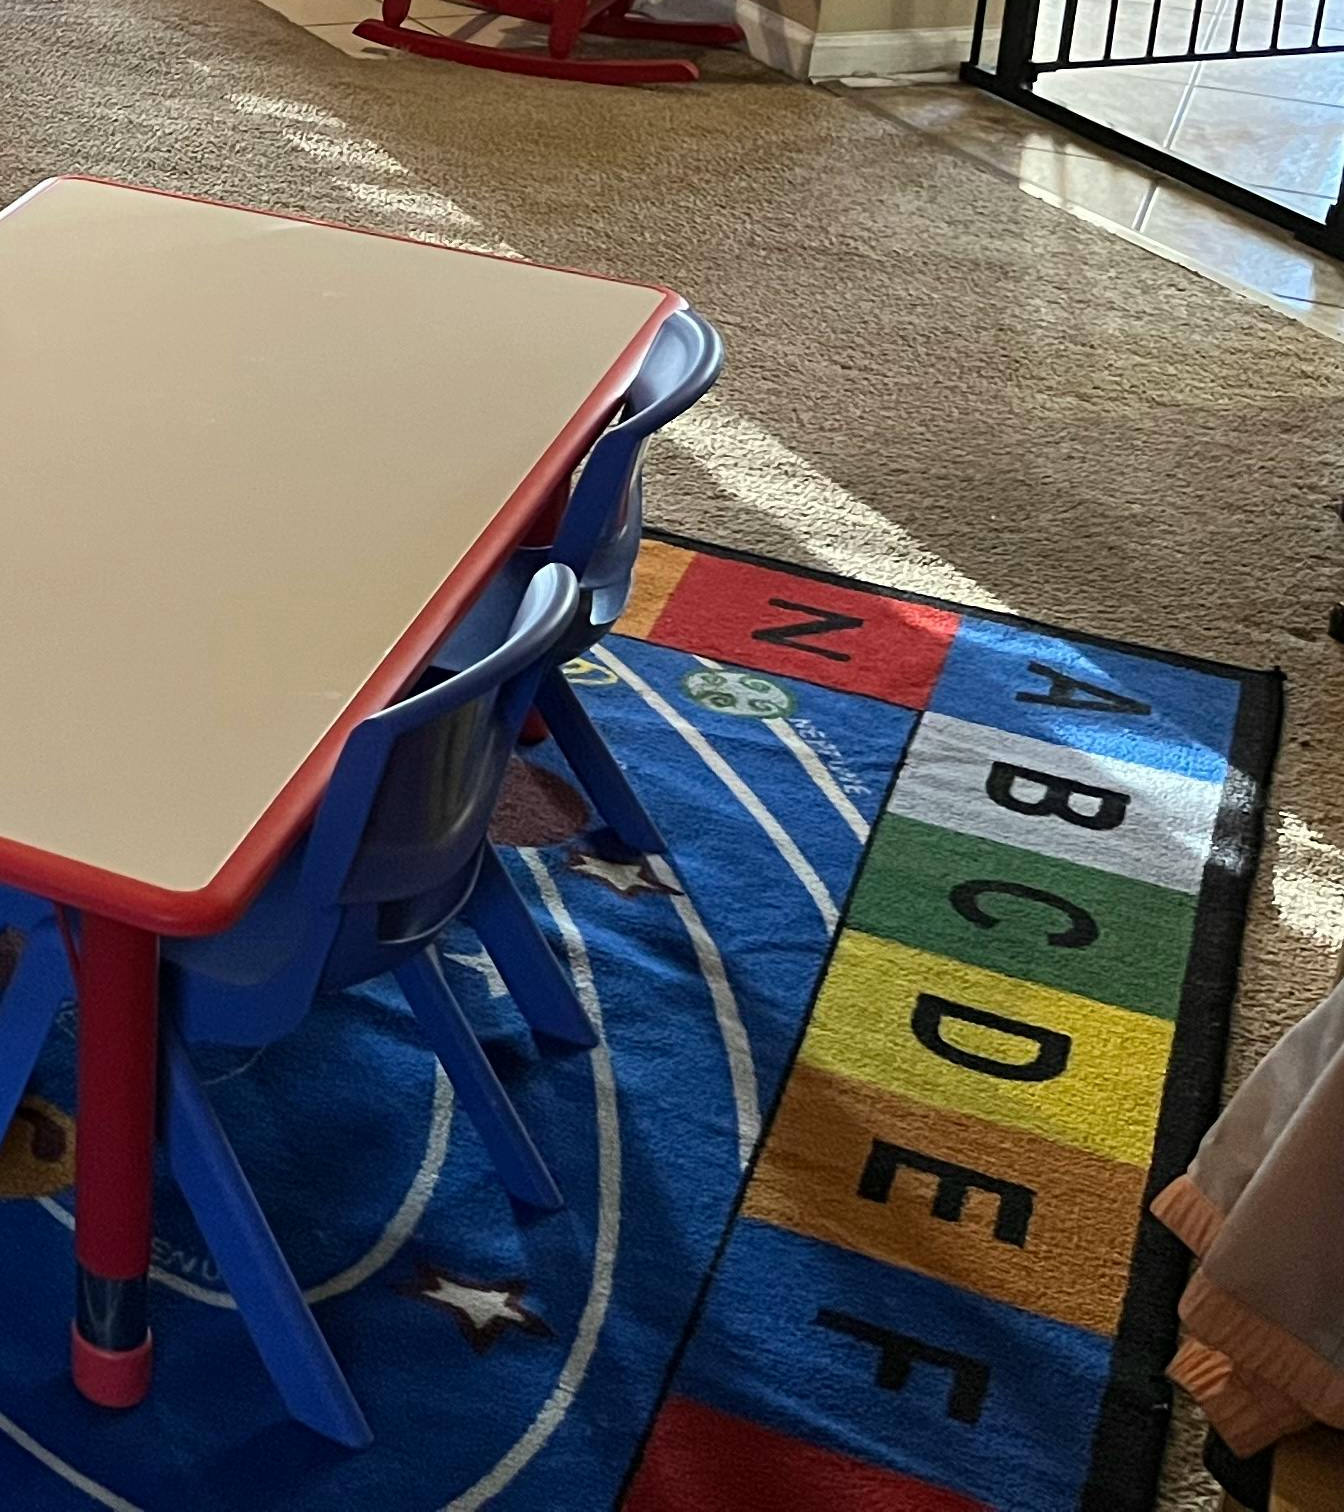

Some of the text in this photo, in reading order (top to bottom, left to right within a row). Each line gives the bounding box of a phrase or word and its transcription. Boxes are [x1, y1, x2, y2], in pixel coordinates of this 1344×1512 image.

[1015, 661, 1152, 716] A
[985, 761, 1130, 832] B
[950, 881, 1099, 950] C
[912, 993, 1072, 1082] D
[857, 1138, 1038, 1248] E
[817, 1306, 993, 1424] F
